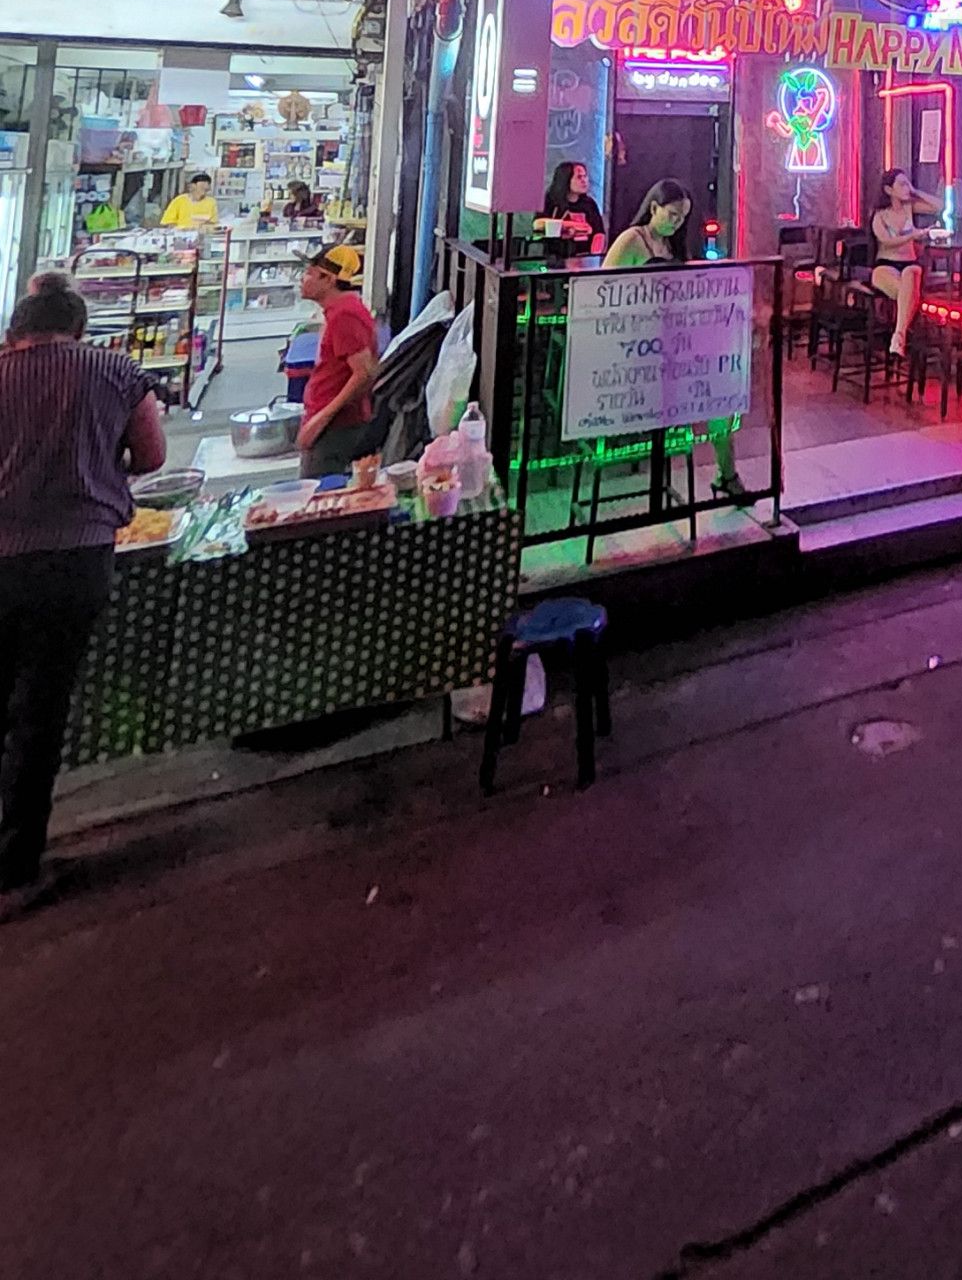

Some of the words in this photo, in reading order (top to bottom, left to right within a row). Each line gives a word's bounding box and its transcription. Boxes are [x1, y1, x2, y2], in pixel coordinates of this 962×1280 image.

[832, 18, 944, 68] HAPPY
[633, 71, 655, 89] by
[657, 71, 720, 88] dundee
